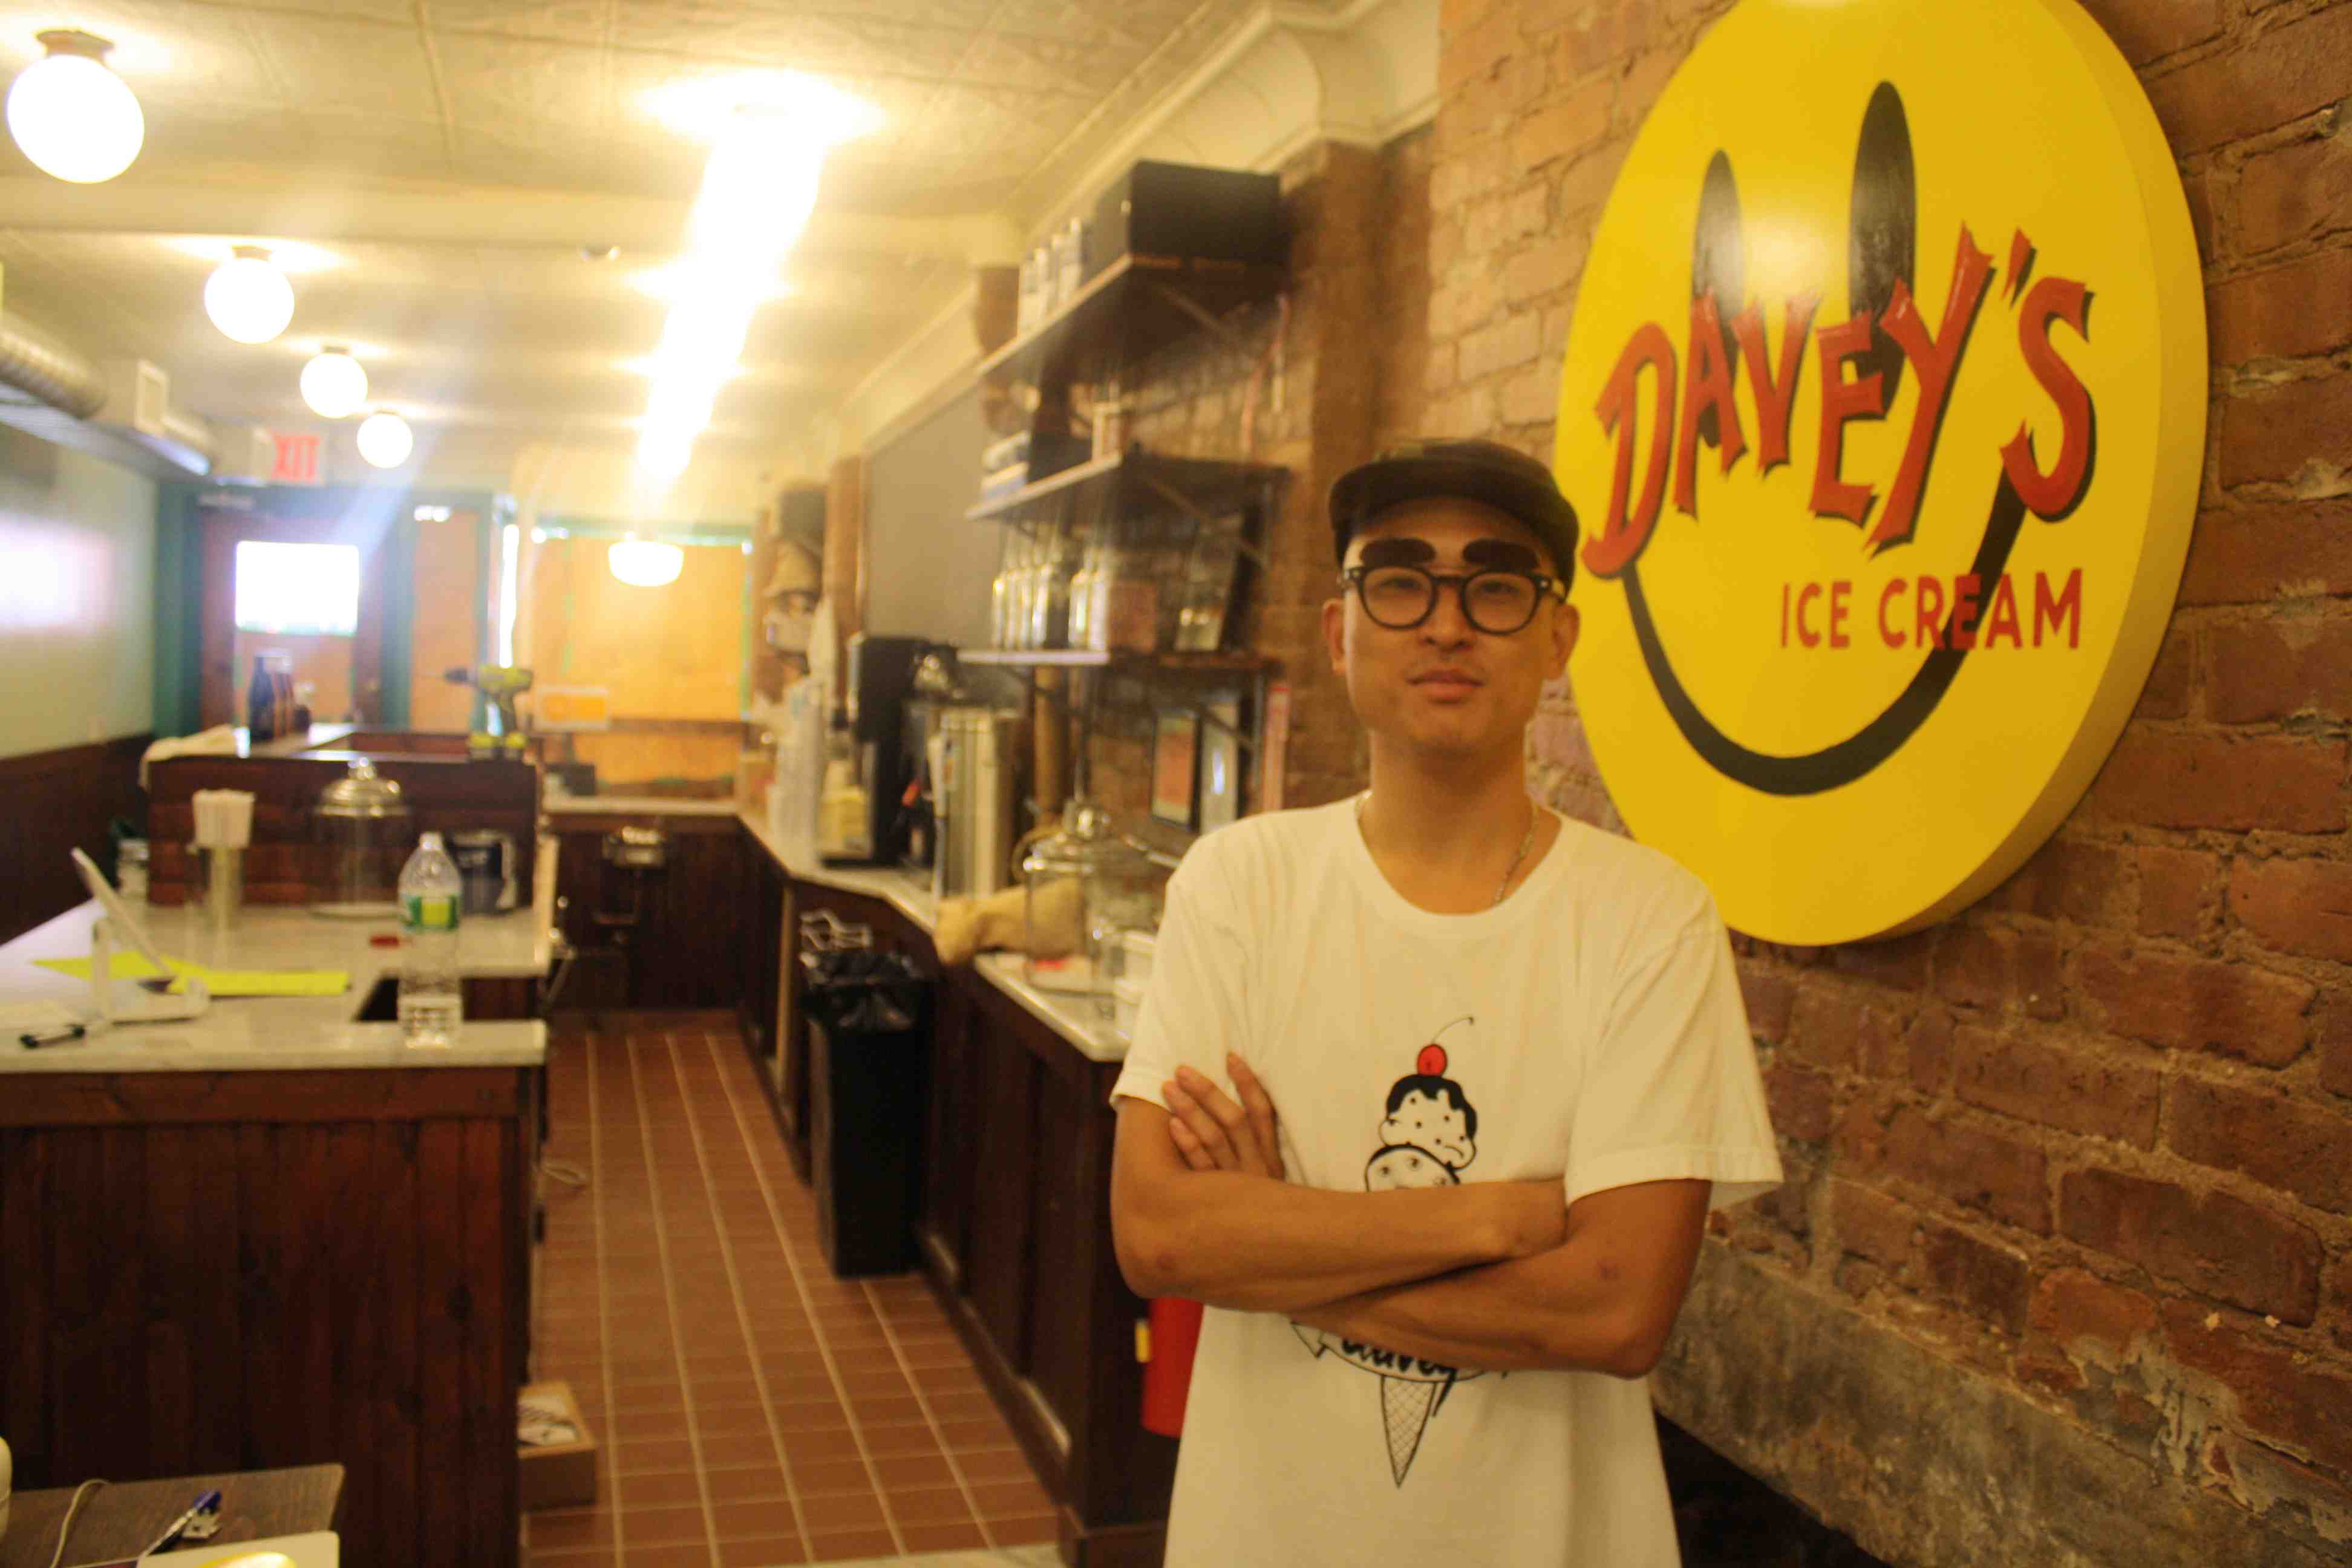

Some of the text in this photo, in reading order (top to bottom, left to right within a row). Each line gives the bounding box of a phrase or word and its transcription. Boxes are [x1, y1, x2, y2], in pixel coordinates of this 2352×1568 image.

[1582, 220, 2094, 576] DAVEY'S
[271, 436, 319, 483] XIT
[1781, 567, 2083, 649] ICE CREAM
